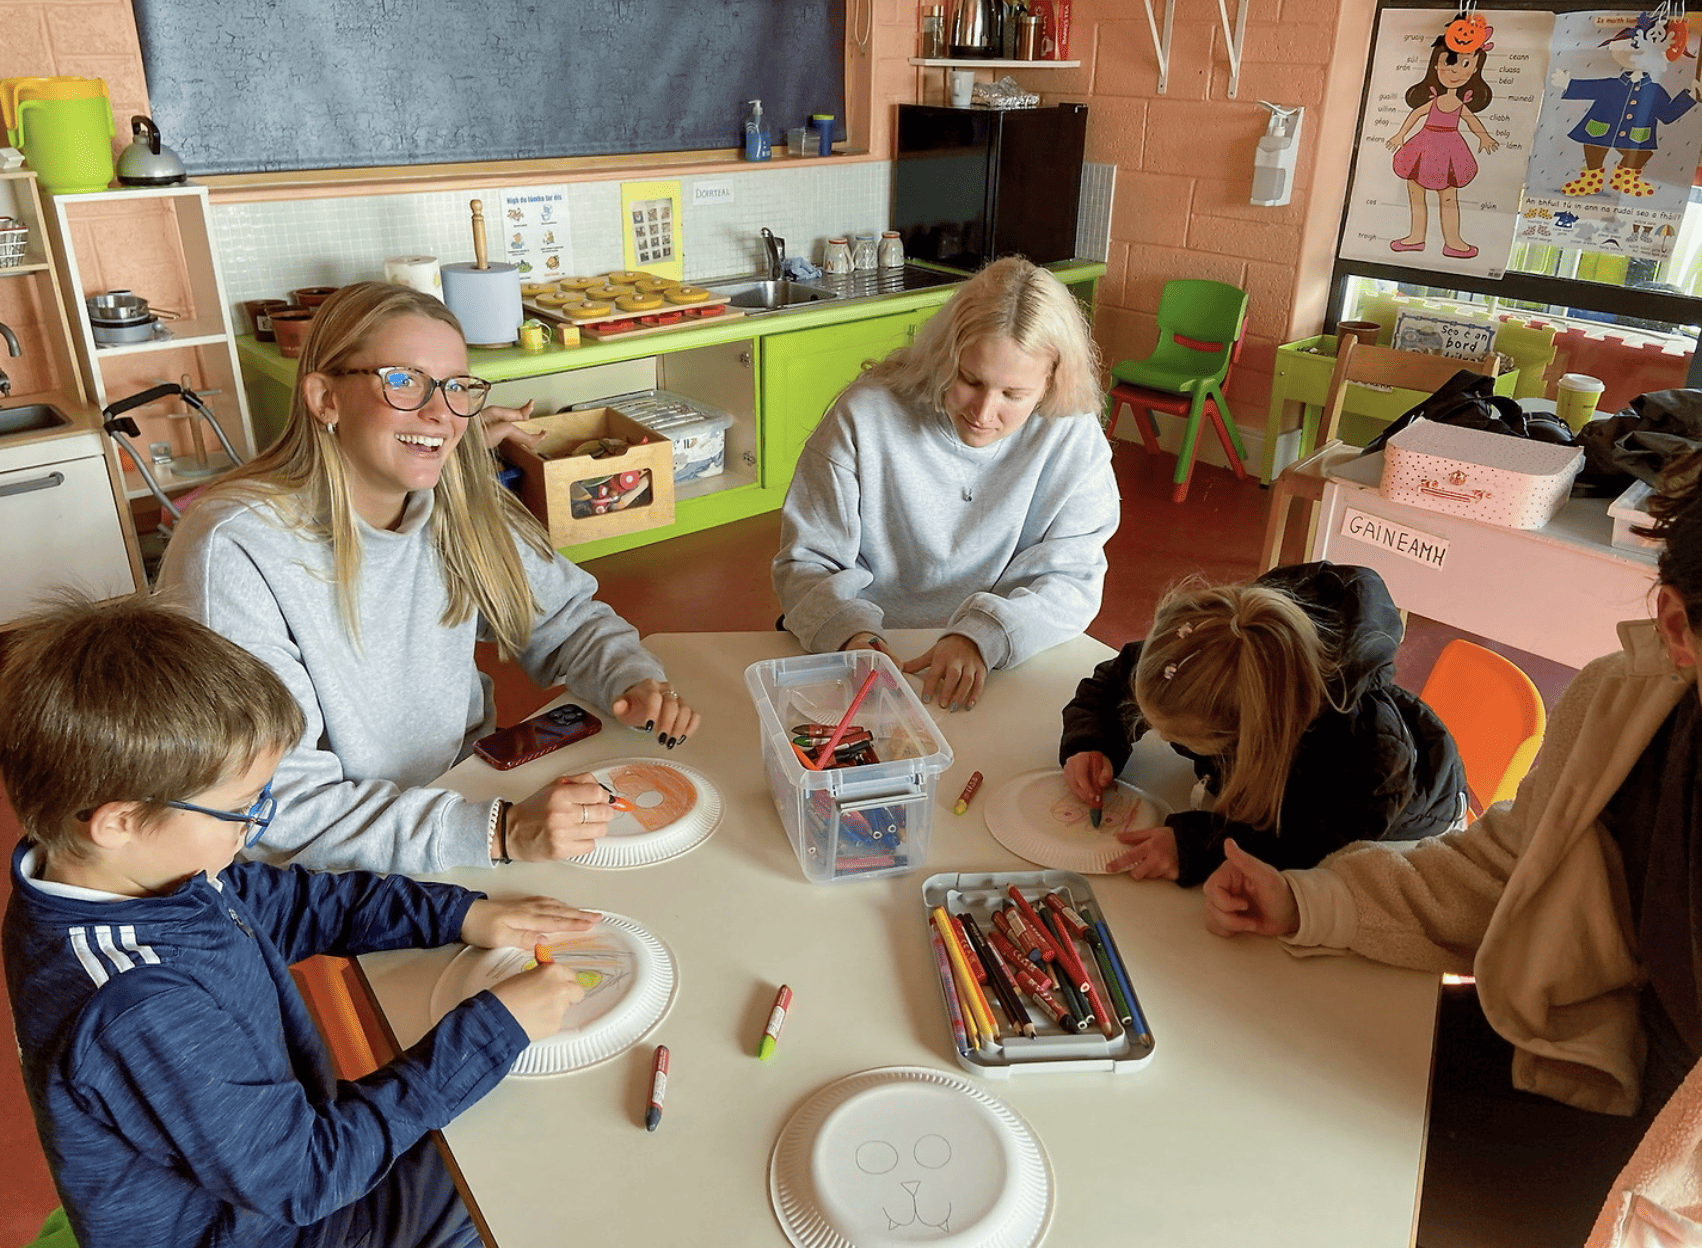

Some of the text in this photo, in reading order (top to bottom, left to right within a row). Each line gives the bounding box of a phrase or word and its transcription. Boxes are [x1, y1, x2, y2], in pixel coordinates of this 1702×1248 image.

[695, 188, 731, 199] DOIRTEAL
[1525, 197, 1536, 205] An
[1636, 210, 1650, 218] seo
[1445, 337, 1478, 353] bord
[1475, 333, 1488, 341] an
[1349, 515, 1446, 567] GAINEAMH
